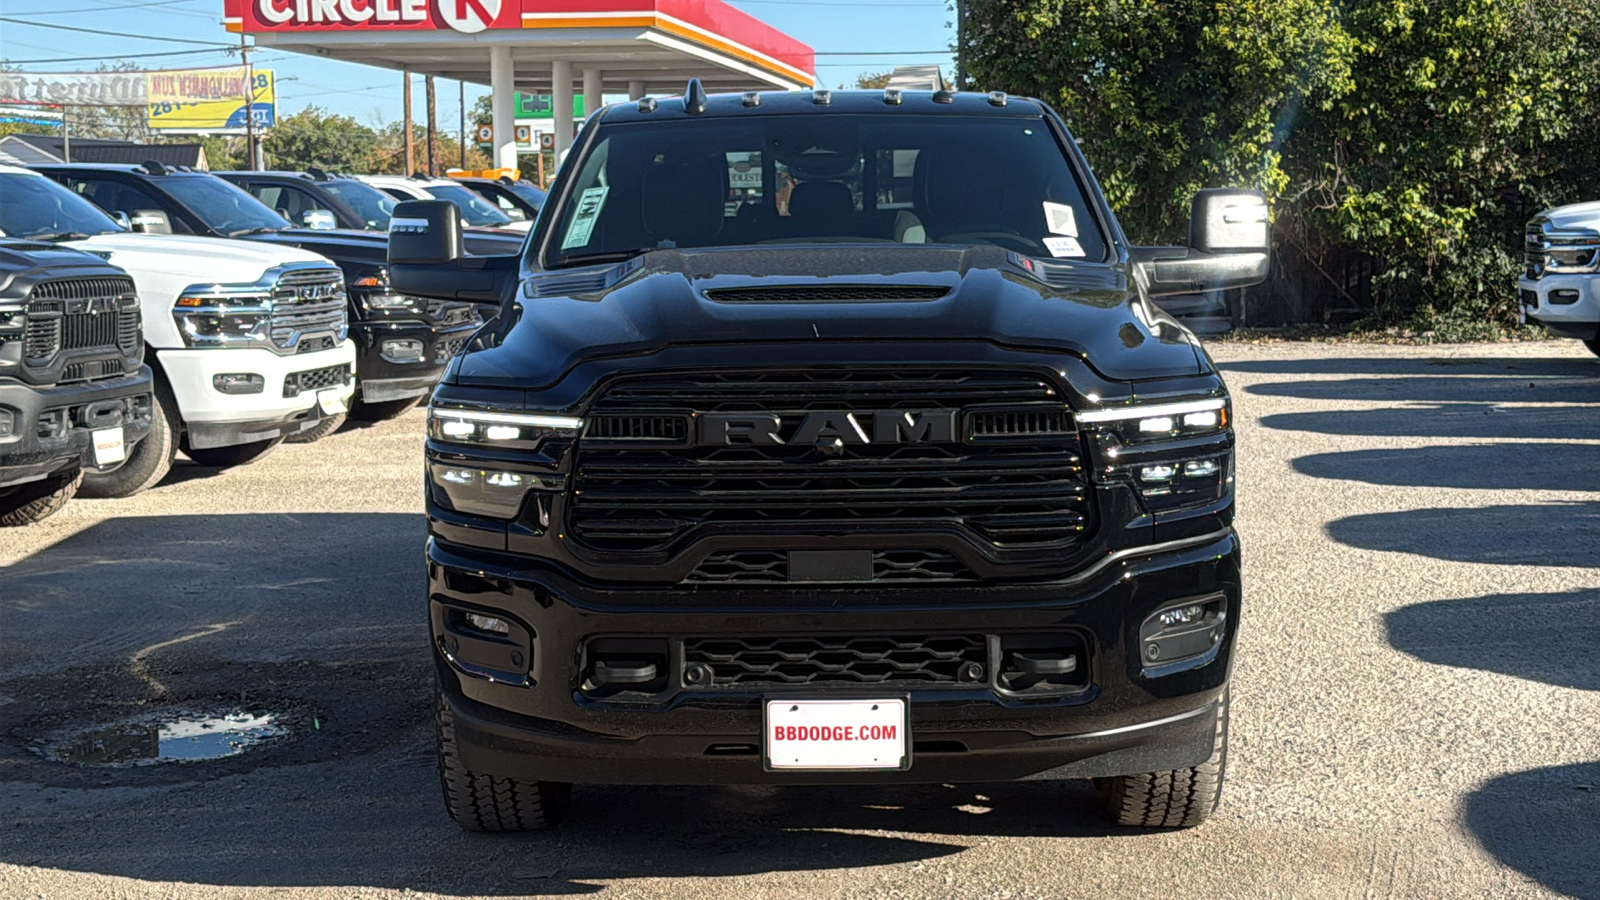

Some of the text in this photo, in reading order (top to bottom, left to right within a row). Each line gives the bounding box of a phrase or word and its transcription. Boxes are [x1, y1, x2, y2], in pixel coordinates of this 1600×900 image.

[260, 0, 428, 23] CIRCLE
[702, 411, 958, 445] RAM
[774, 725, 897, 741] BBDODGE.COM
